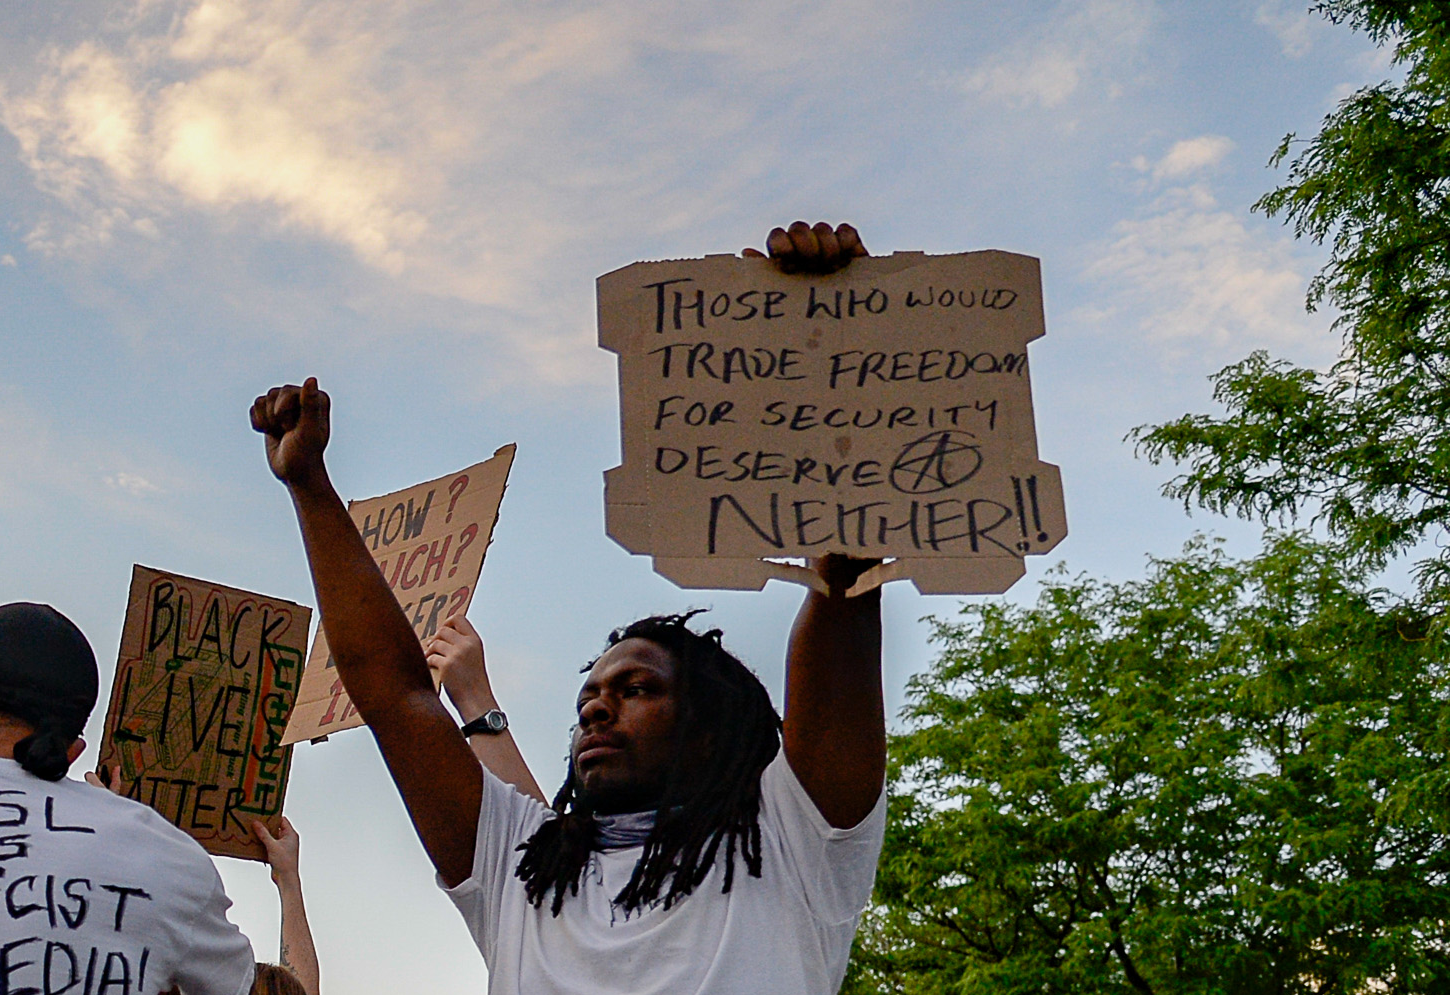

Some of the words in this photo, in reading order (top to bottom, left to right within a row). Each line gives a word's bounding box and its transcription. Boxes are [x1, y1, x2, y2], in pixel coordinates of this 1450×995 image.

[642, 277, 787, 334] THOSE
[805, 285, 889, 320] WHO
[905, 285, 1019, 311] WOULD
[648, 341, 807, 385] TRADE
[828, 348, 1028, 390] FREEDOM
[653, 396, 737, 431] FOR
[760, 399, 999, 431] SECURITY
[654, 445, 886, 488] DESERVE
[707, 475, 1049, 558] NEITHER!!
[378, 522, 479, 592] UCH?
[149, 581, 286, 676] BLACK
[113, 665, 284, 763] LIVES
